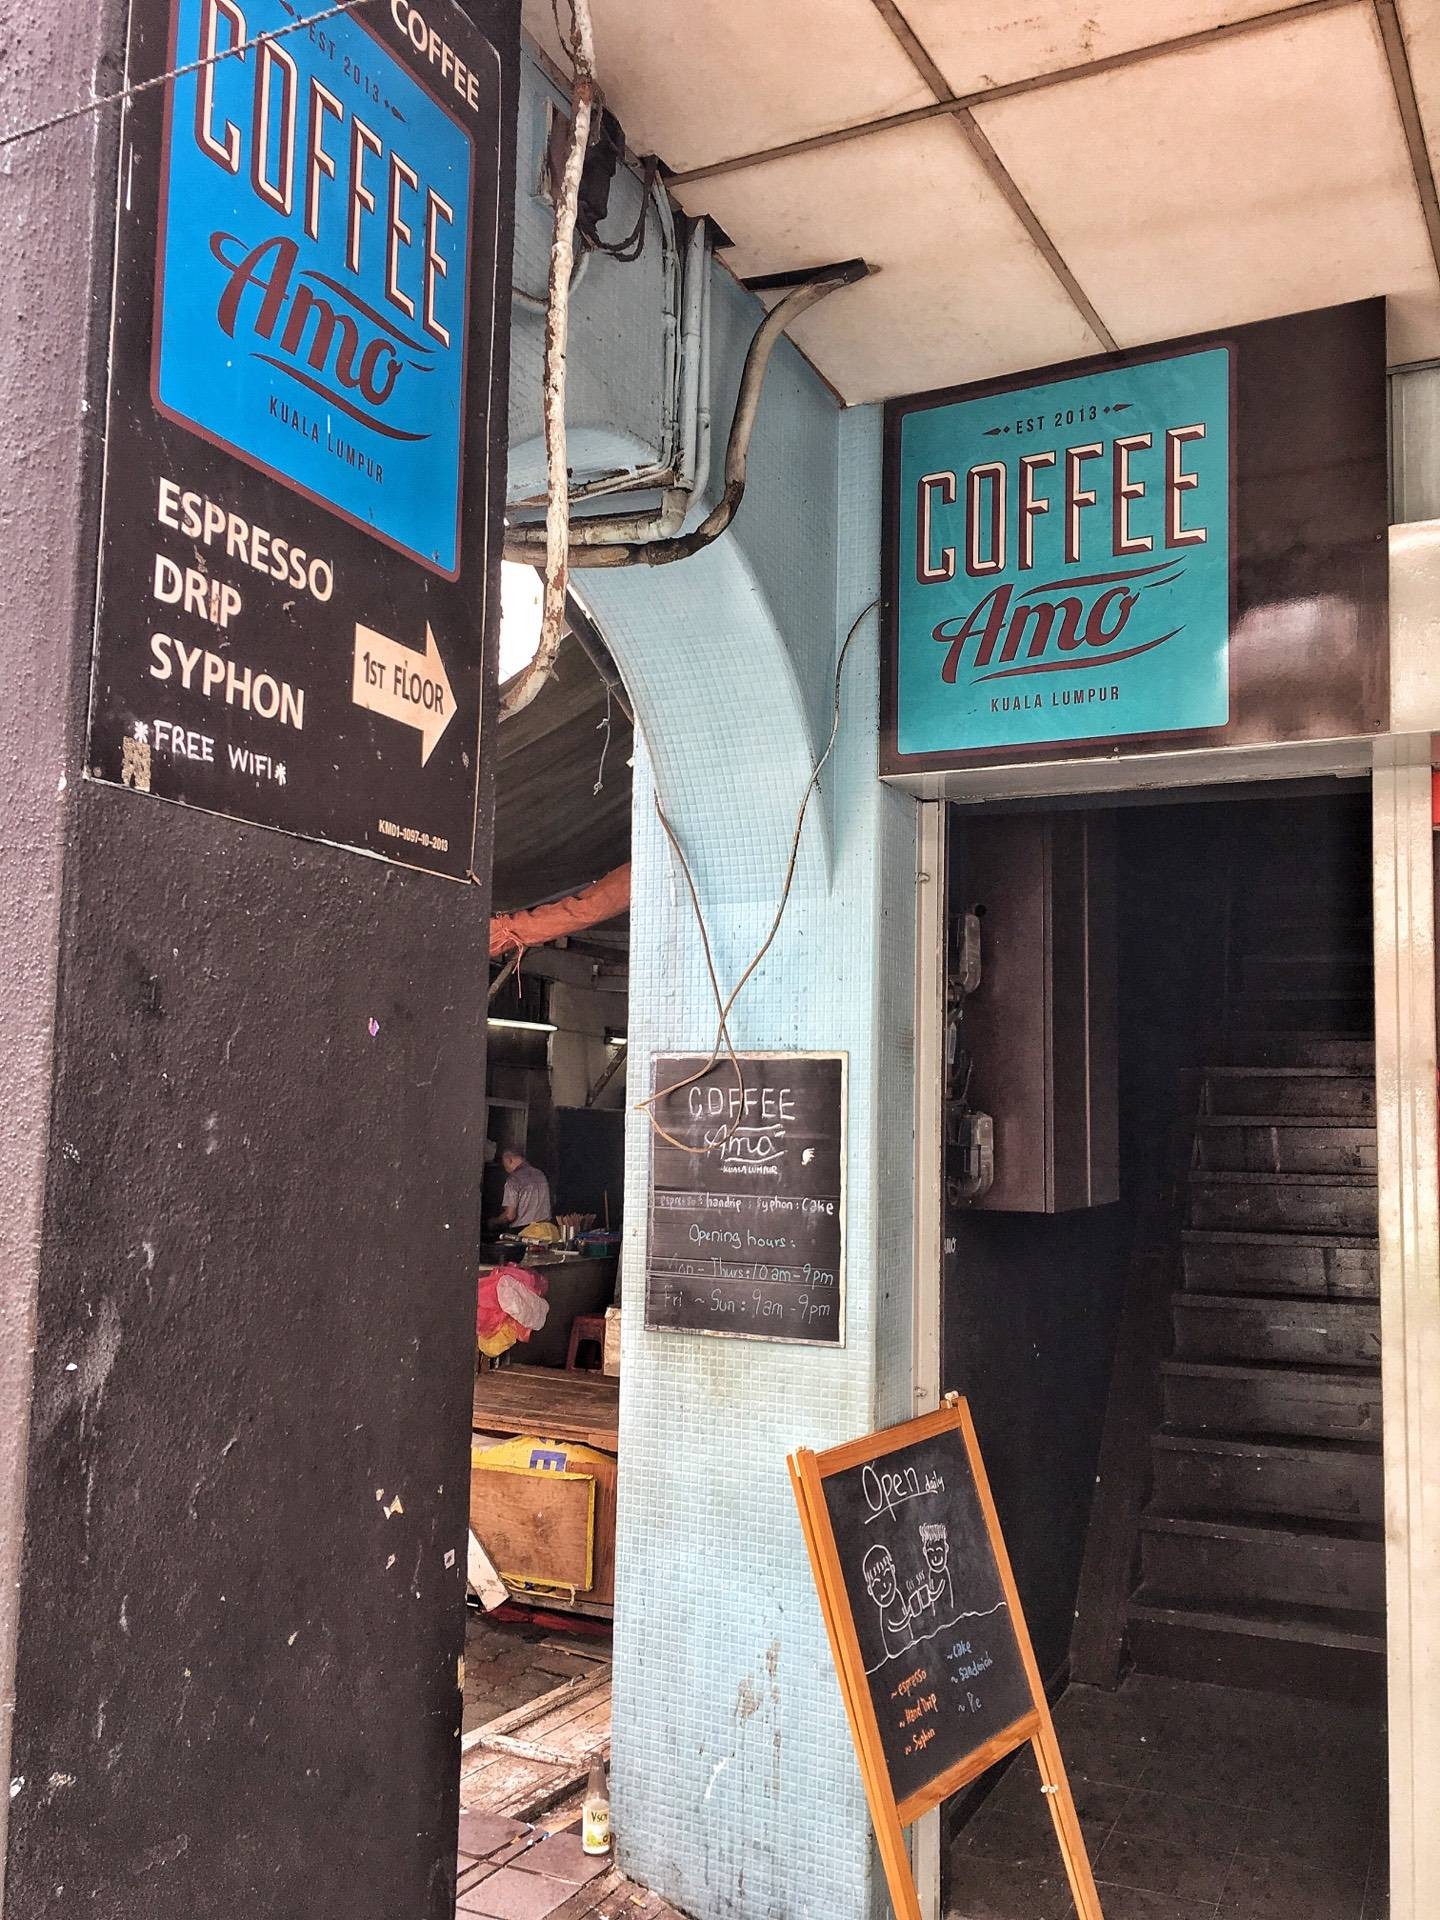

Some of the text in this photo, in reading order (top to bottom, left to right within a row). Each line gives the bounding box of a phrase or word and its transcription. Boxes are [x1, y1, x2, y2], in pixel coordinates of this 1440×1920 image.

[308, 22, 380, 104] EST 2013
[391, 0, 480, 113] COFFEE
[194, 0, 454, 350] COFFEE
[209, 231, 403, 405] Amo
[269, 394, 384, 485] KUALA LUMPUR
[1015, 405, 1098, 435] EST 2013
[158, 476, 334, 602] ESPRESSO
[916, 422, 1208, 585] COFFEE
[153, 553, 242, 628] DRIP
[931, 582, 1141, 685] Amo
[149, 633, 305, 731] SYPHON
[363, 651, 444, 715] 1ST FLOOR
[990, 685, 1120, 713] KUALA LUMPUR
[688, 1086, 796, 1121] COFFEE
[704, 1124, 774, 1161] Amo
[688, 1223, 742, 1249] Opening
[862, 1461, 921, 1522] Open
